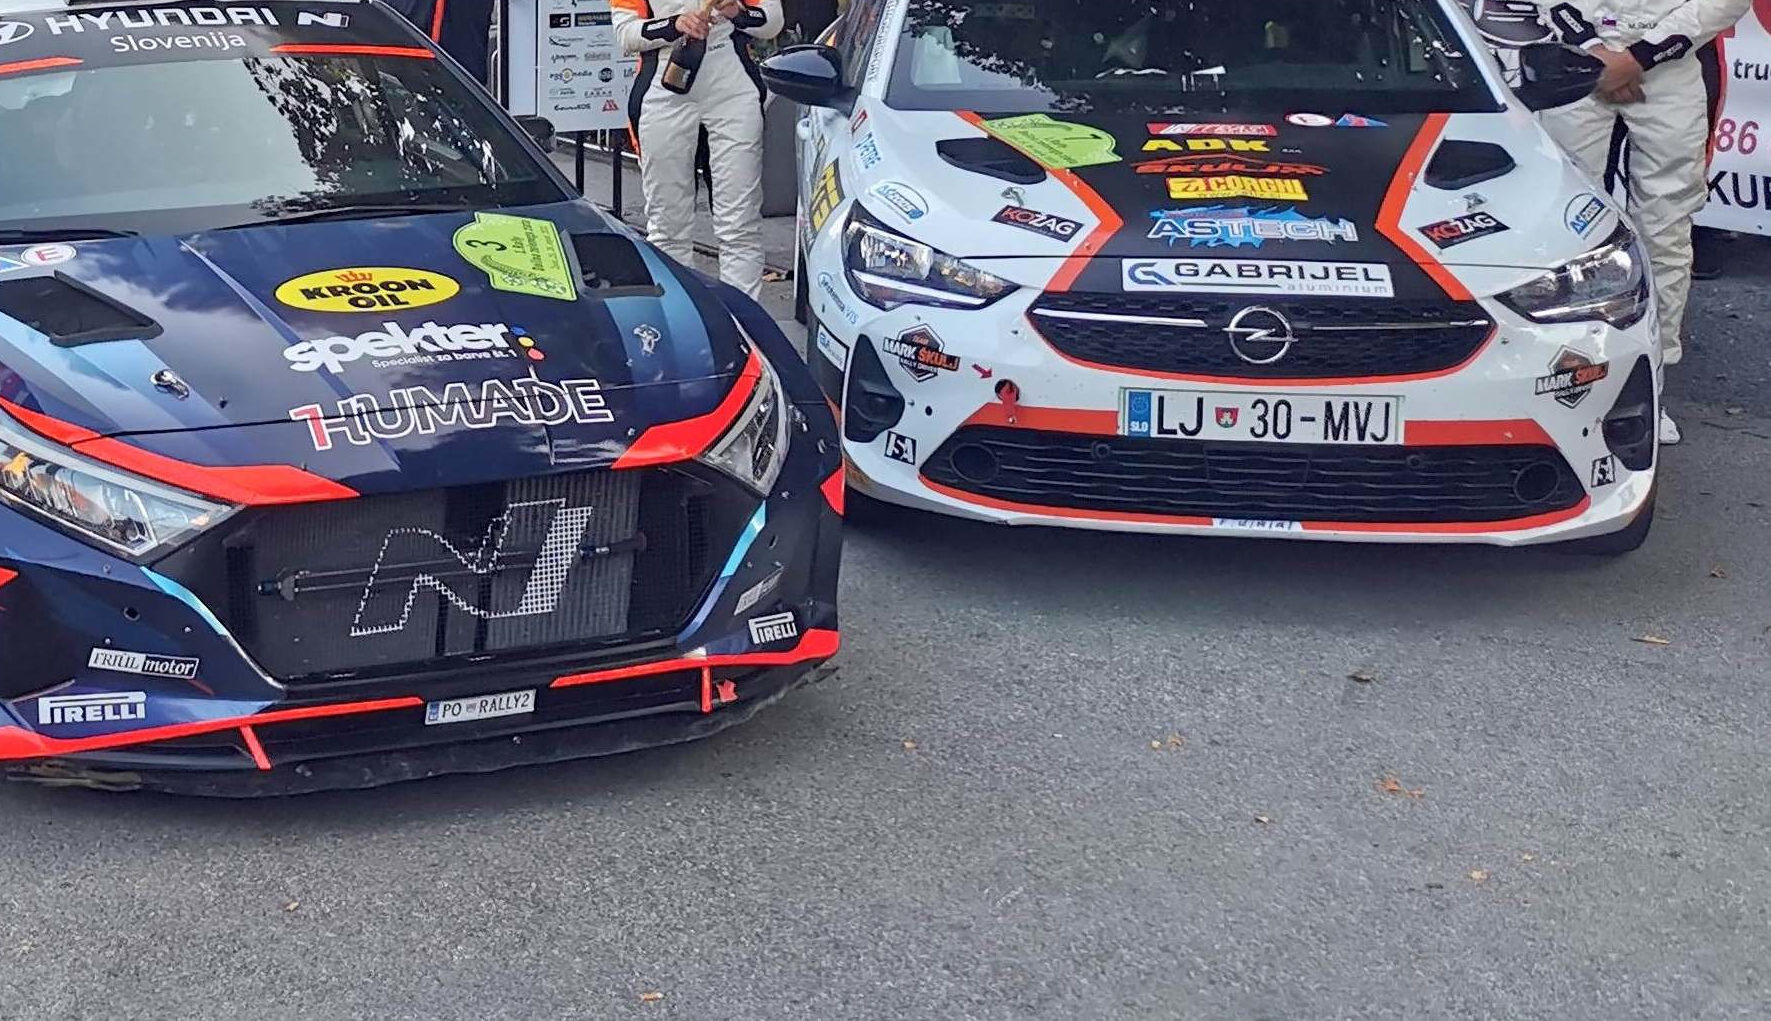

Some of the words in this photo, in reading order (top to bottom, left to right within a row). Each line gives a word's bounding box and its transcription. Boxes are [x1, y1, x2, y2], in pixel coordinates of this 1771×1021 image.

[46, 6, 280, 36] HYUNDAI
[110, 30, 247, 54] Slovenija
[1142, 138, 1271, 153] ADK
[1716, 118, 1760, 155] 86
[1003, 207, 1076, 237] KOZAG
[1147, 217, 1360, 242] ASTECH
[1425, 215, 1499, 244] KOZAG
[1174, 261, 1385, 283] GABRIJEL
[299, 278, 437, 302] KROON
[348, 292, 411, 310] OIL
[1287, 282, 1389, 295] aluminium
[283, 322, 510, 374] spekter
[372, 355, 434, 369] Specialist
[437, 353, 453, 362] za
[455, 349, 492, 361] barve
[883, 338, 916, 359] MARK
[918, 346, 958, 370] ŠKULJ
[1130, 420, 1149, 433] SLO
[1157, 394, 1204, 436] LJ
[1249, 398, 1392, 442] 30-MVJ
[748, 611, 798, 645] PIRELLI
[144, 656, 195, 676] motor
[38, 690, 146, 725] PIRELLI
[442, 701, 462, 718] PO
[479, 692, 531, 715] RALLY2
